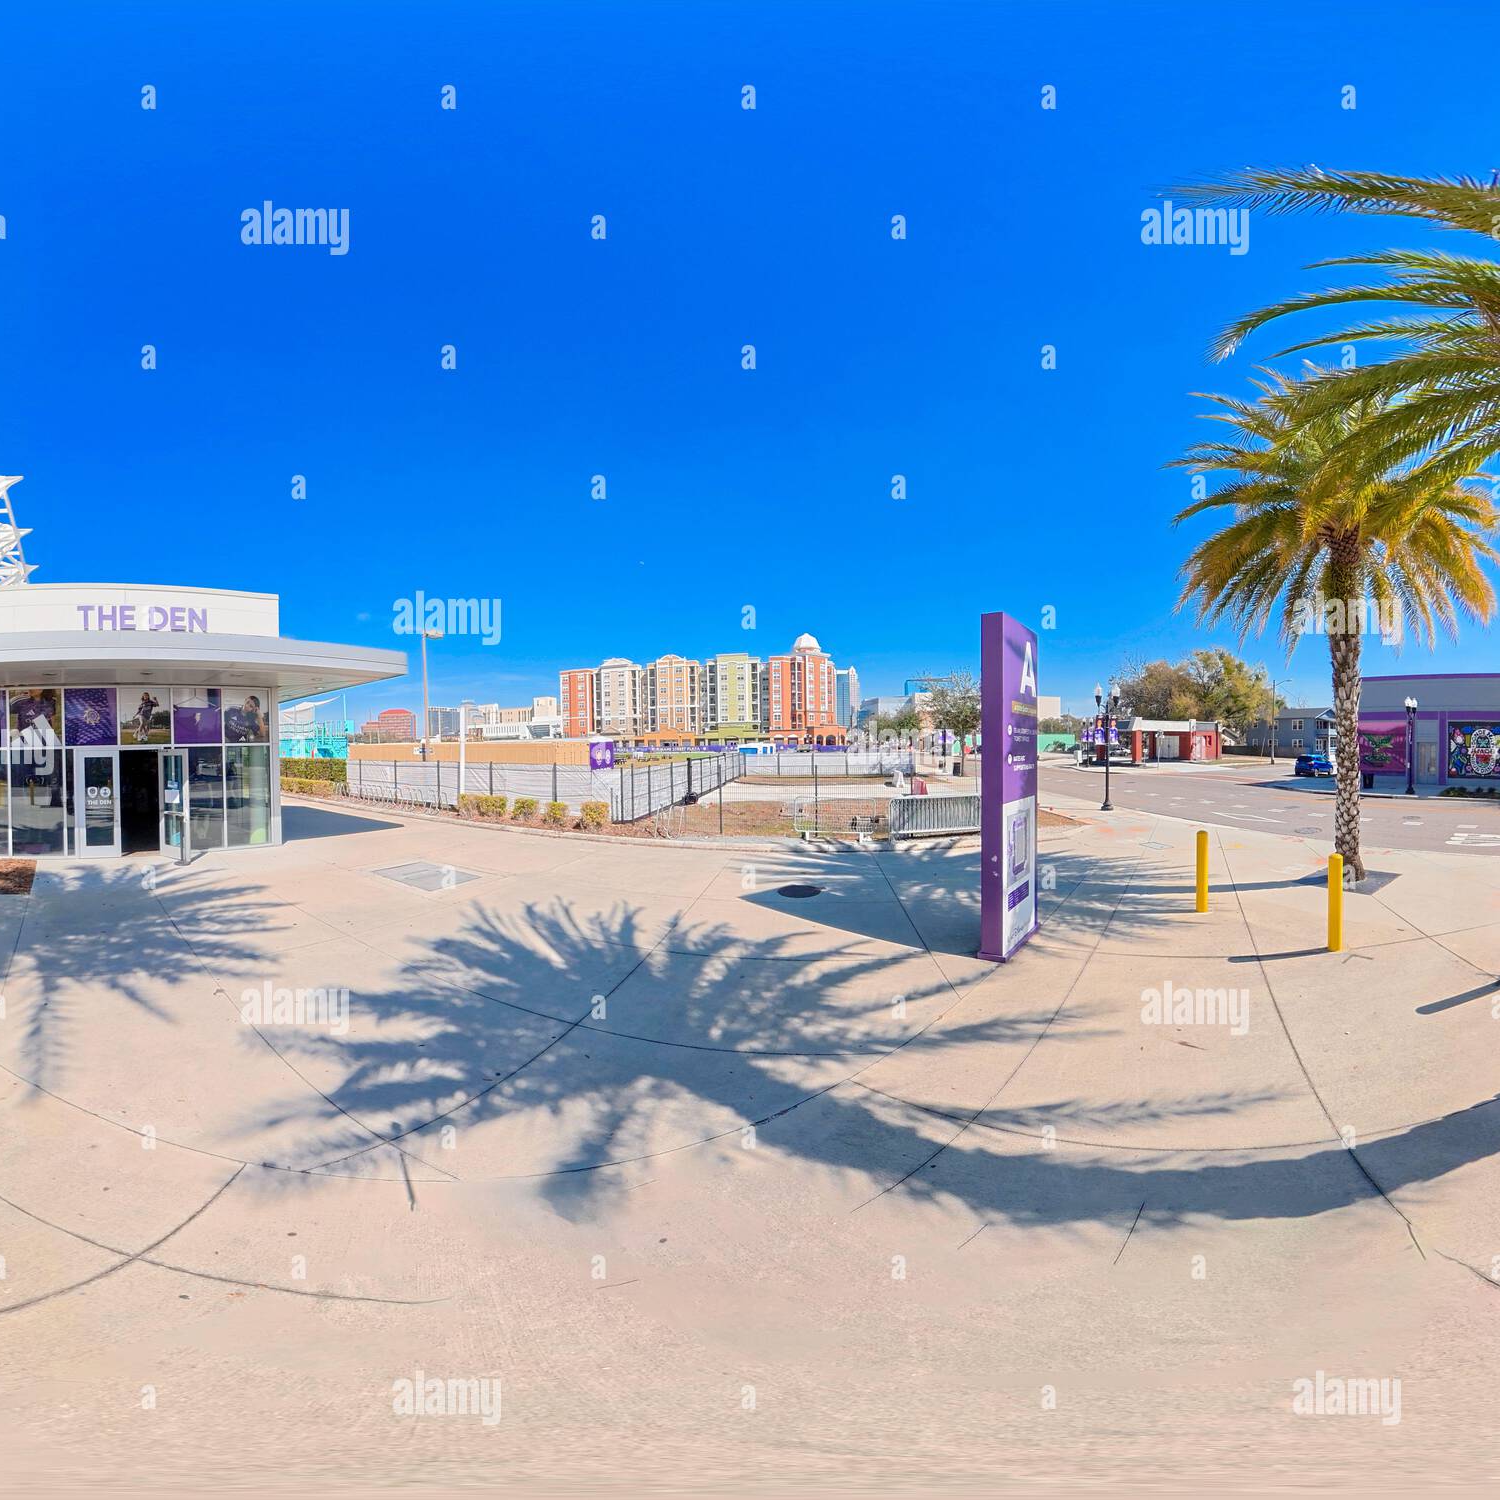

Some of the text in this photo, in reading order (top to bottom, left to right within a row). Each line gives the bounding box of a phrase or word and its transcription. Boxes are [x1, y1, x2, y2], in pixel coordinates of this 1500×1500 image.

[77, 605, 207, 633] THE DEN
[1019, 641, 1037, 698] A
